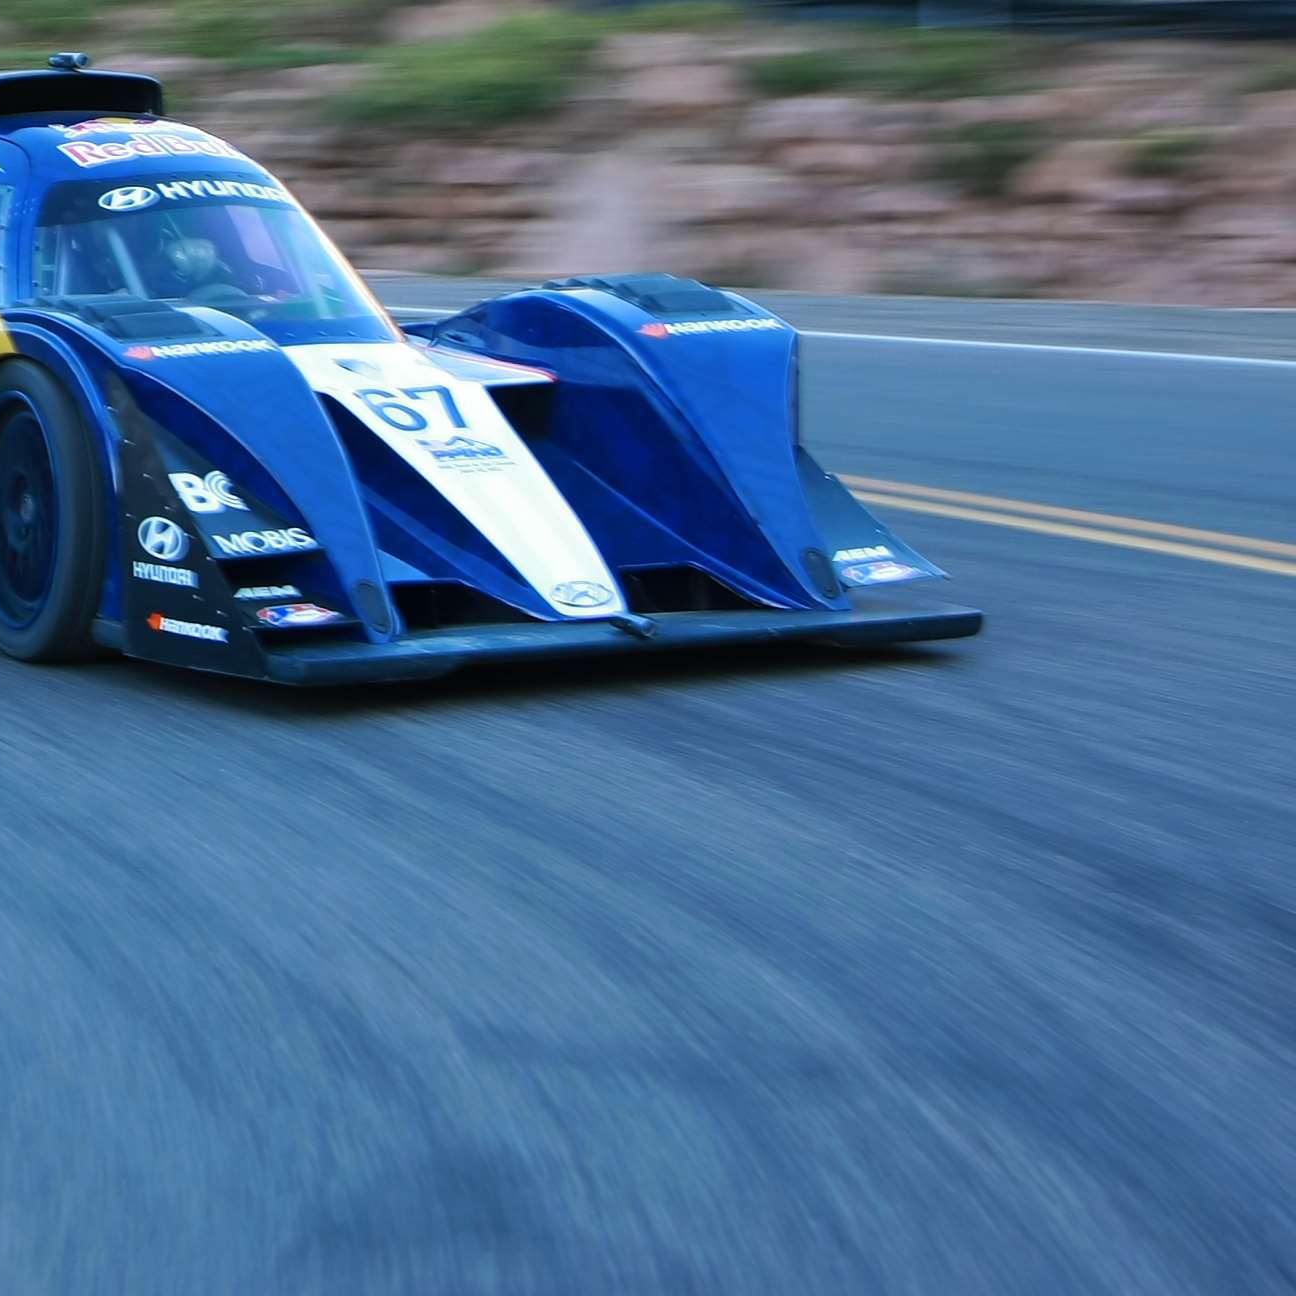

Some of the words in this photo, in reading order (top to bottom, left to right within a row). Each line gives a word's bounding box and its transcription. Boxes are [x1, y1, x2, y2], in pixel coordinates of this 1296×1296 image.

[156, 180, 292, 204] HYUNDA
[353, 384, 470, 432] 67
[167, 470, 251, 514] BC
[212, 527, 319, 555] MOBIS
[132, 560, 199, 589] HYUNDAI
